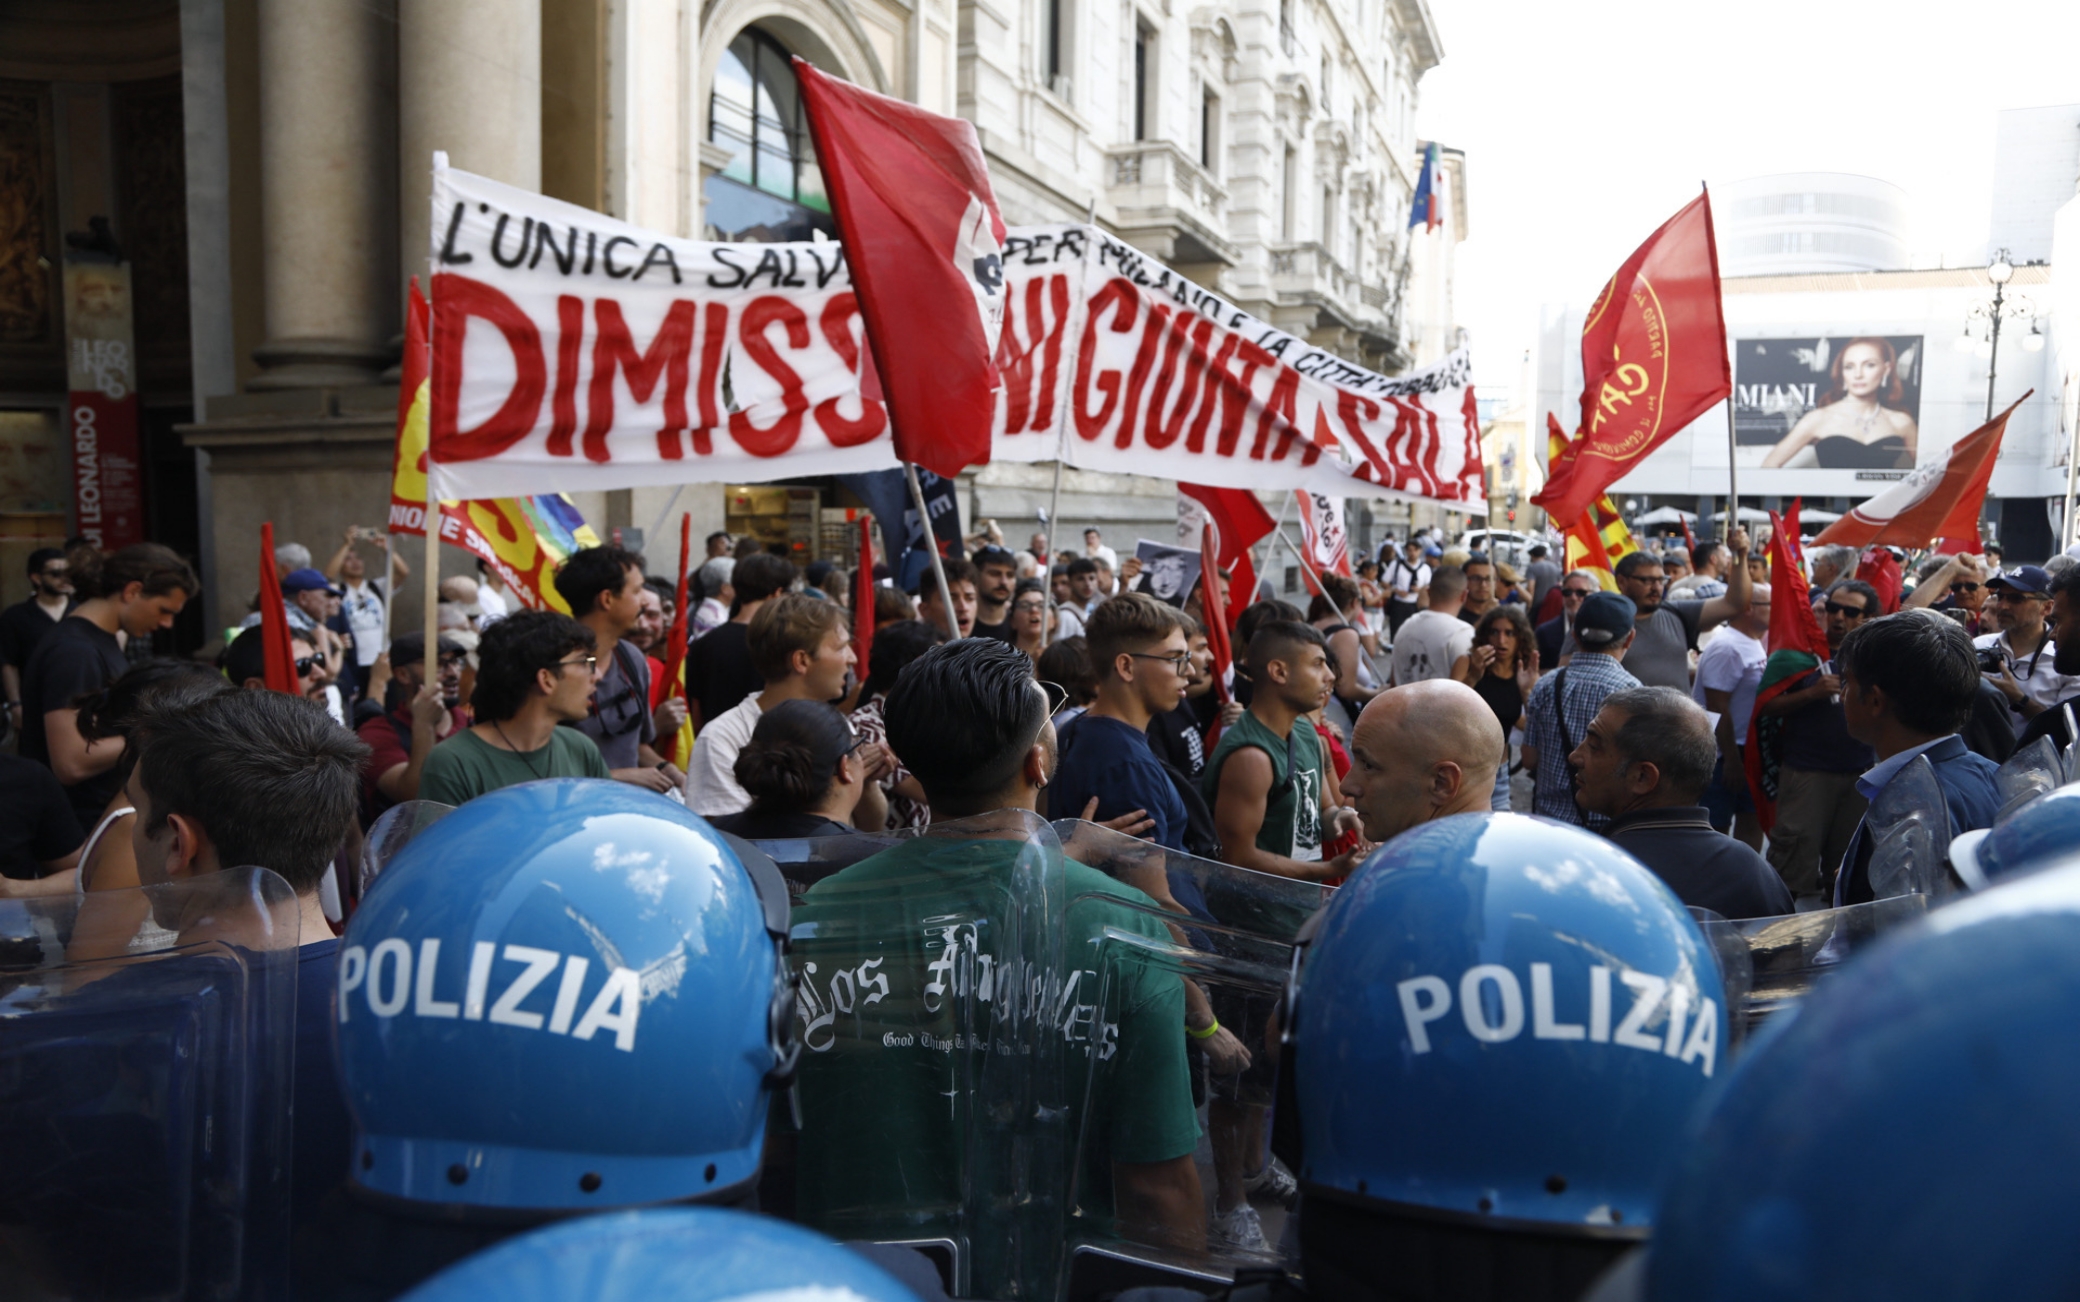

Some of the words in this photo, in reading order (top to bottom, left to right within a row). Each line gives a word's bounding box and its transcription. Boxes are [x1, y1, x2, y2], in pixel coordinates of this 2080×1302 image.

[440, 202, 682, 285] L'UNICA
[707, 247, 853, 290] SALV
[1001, 230, 1085, 265] PER
[1072, 278, 1323, 467] GIUNTA
[1336, 386, 1488, 502] SALA
[74, 406, 102, 523] LEONARDO
[338, 937, 641, 1053] POLIZIA
[797, 955, 890, 1052] Los
[883, 1031, 914, 1048] Good
[921, 1031, 952, 1054] Things
[1396, 961, 1718, 1078] POLIZIA
